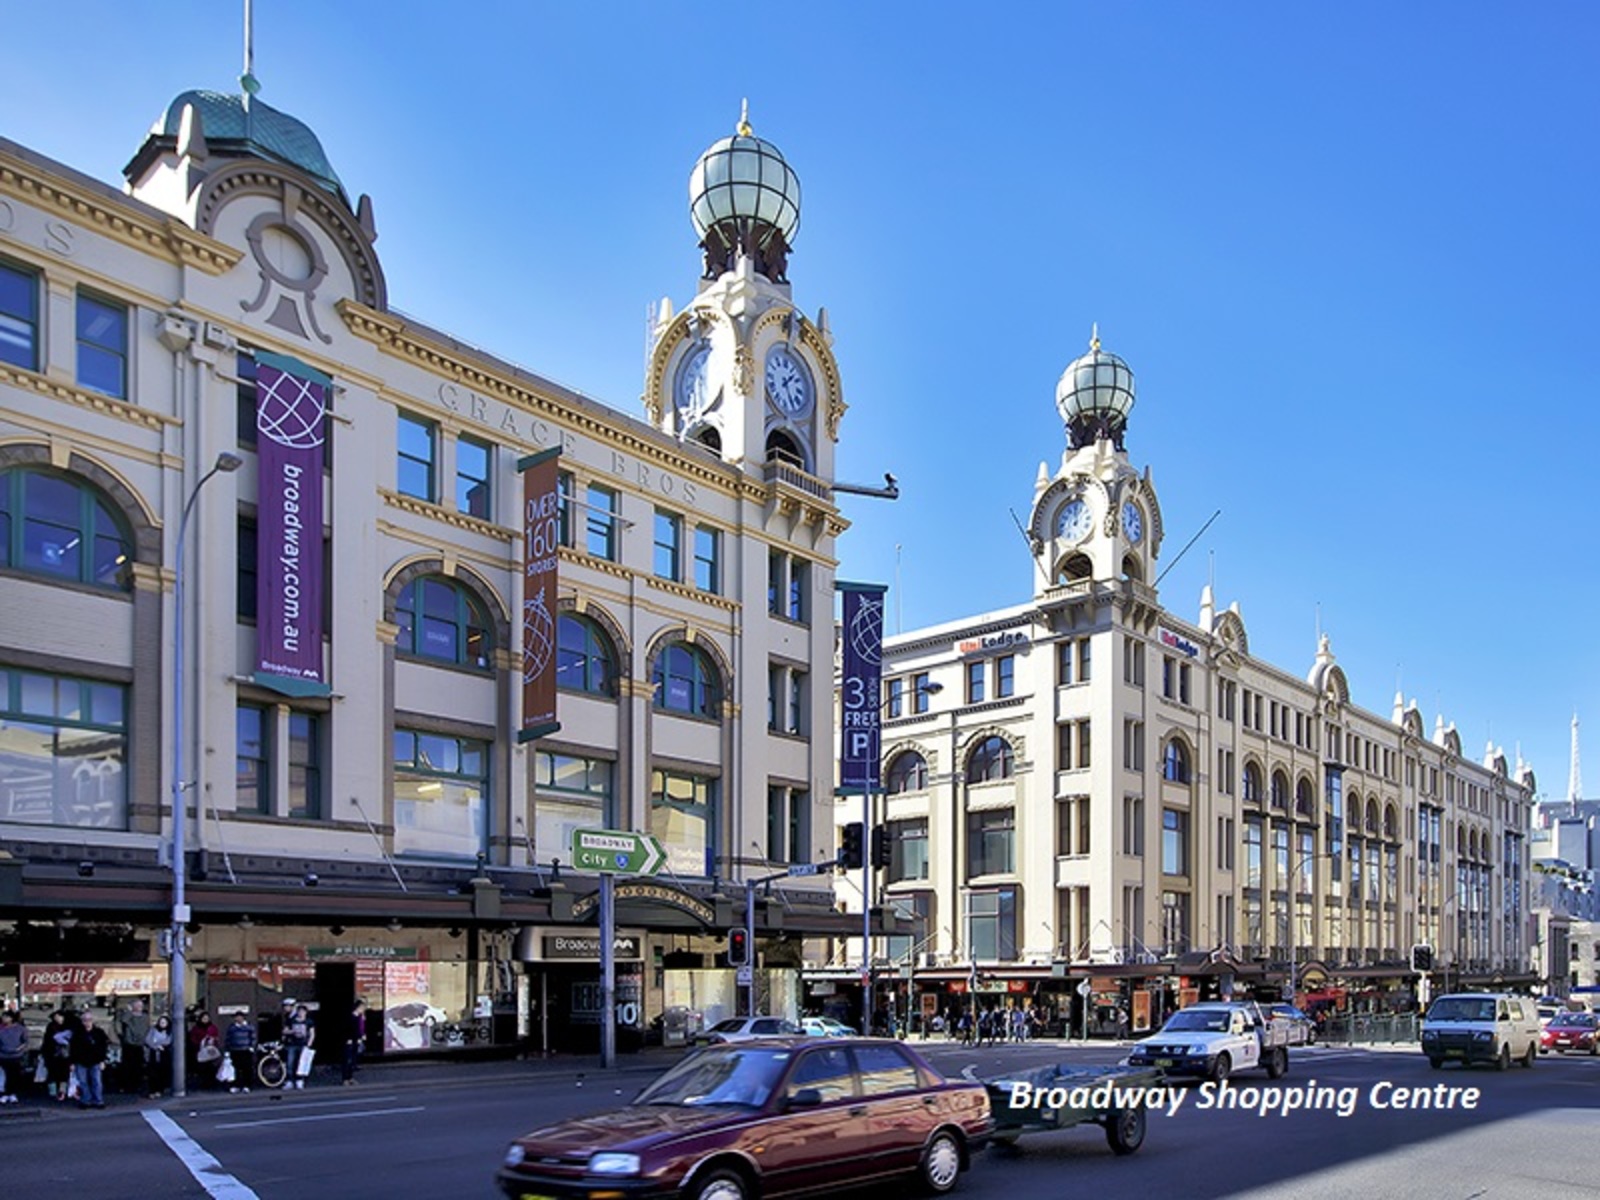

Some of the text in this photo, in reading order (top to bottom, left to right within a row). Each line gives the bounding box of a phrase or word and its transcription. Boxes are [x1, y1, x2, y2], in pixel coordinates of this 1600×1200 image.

[438, 382, 697, 505] GRACE BROS
[526, 491, 556, 522] OVER
[526, 517, 556, 560] 160
[280, 463, 303, 652] broadway.com.au
[845, 676, 866, 709] 3
[844, 711, 879, 727] FREE
[852, 733, 869, 757] P
[583, 836, 633, 849] BROADWAY
[581, 853, 608, 867] City
[28, 968, 73, 985] need
[73, 969, 97, 984] it?
